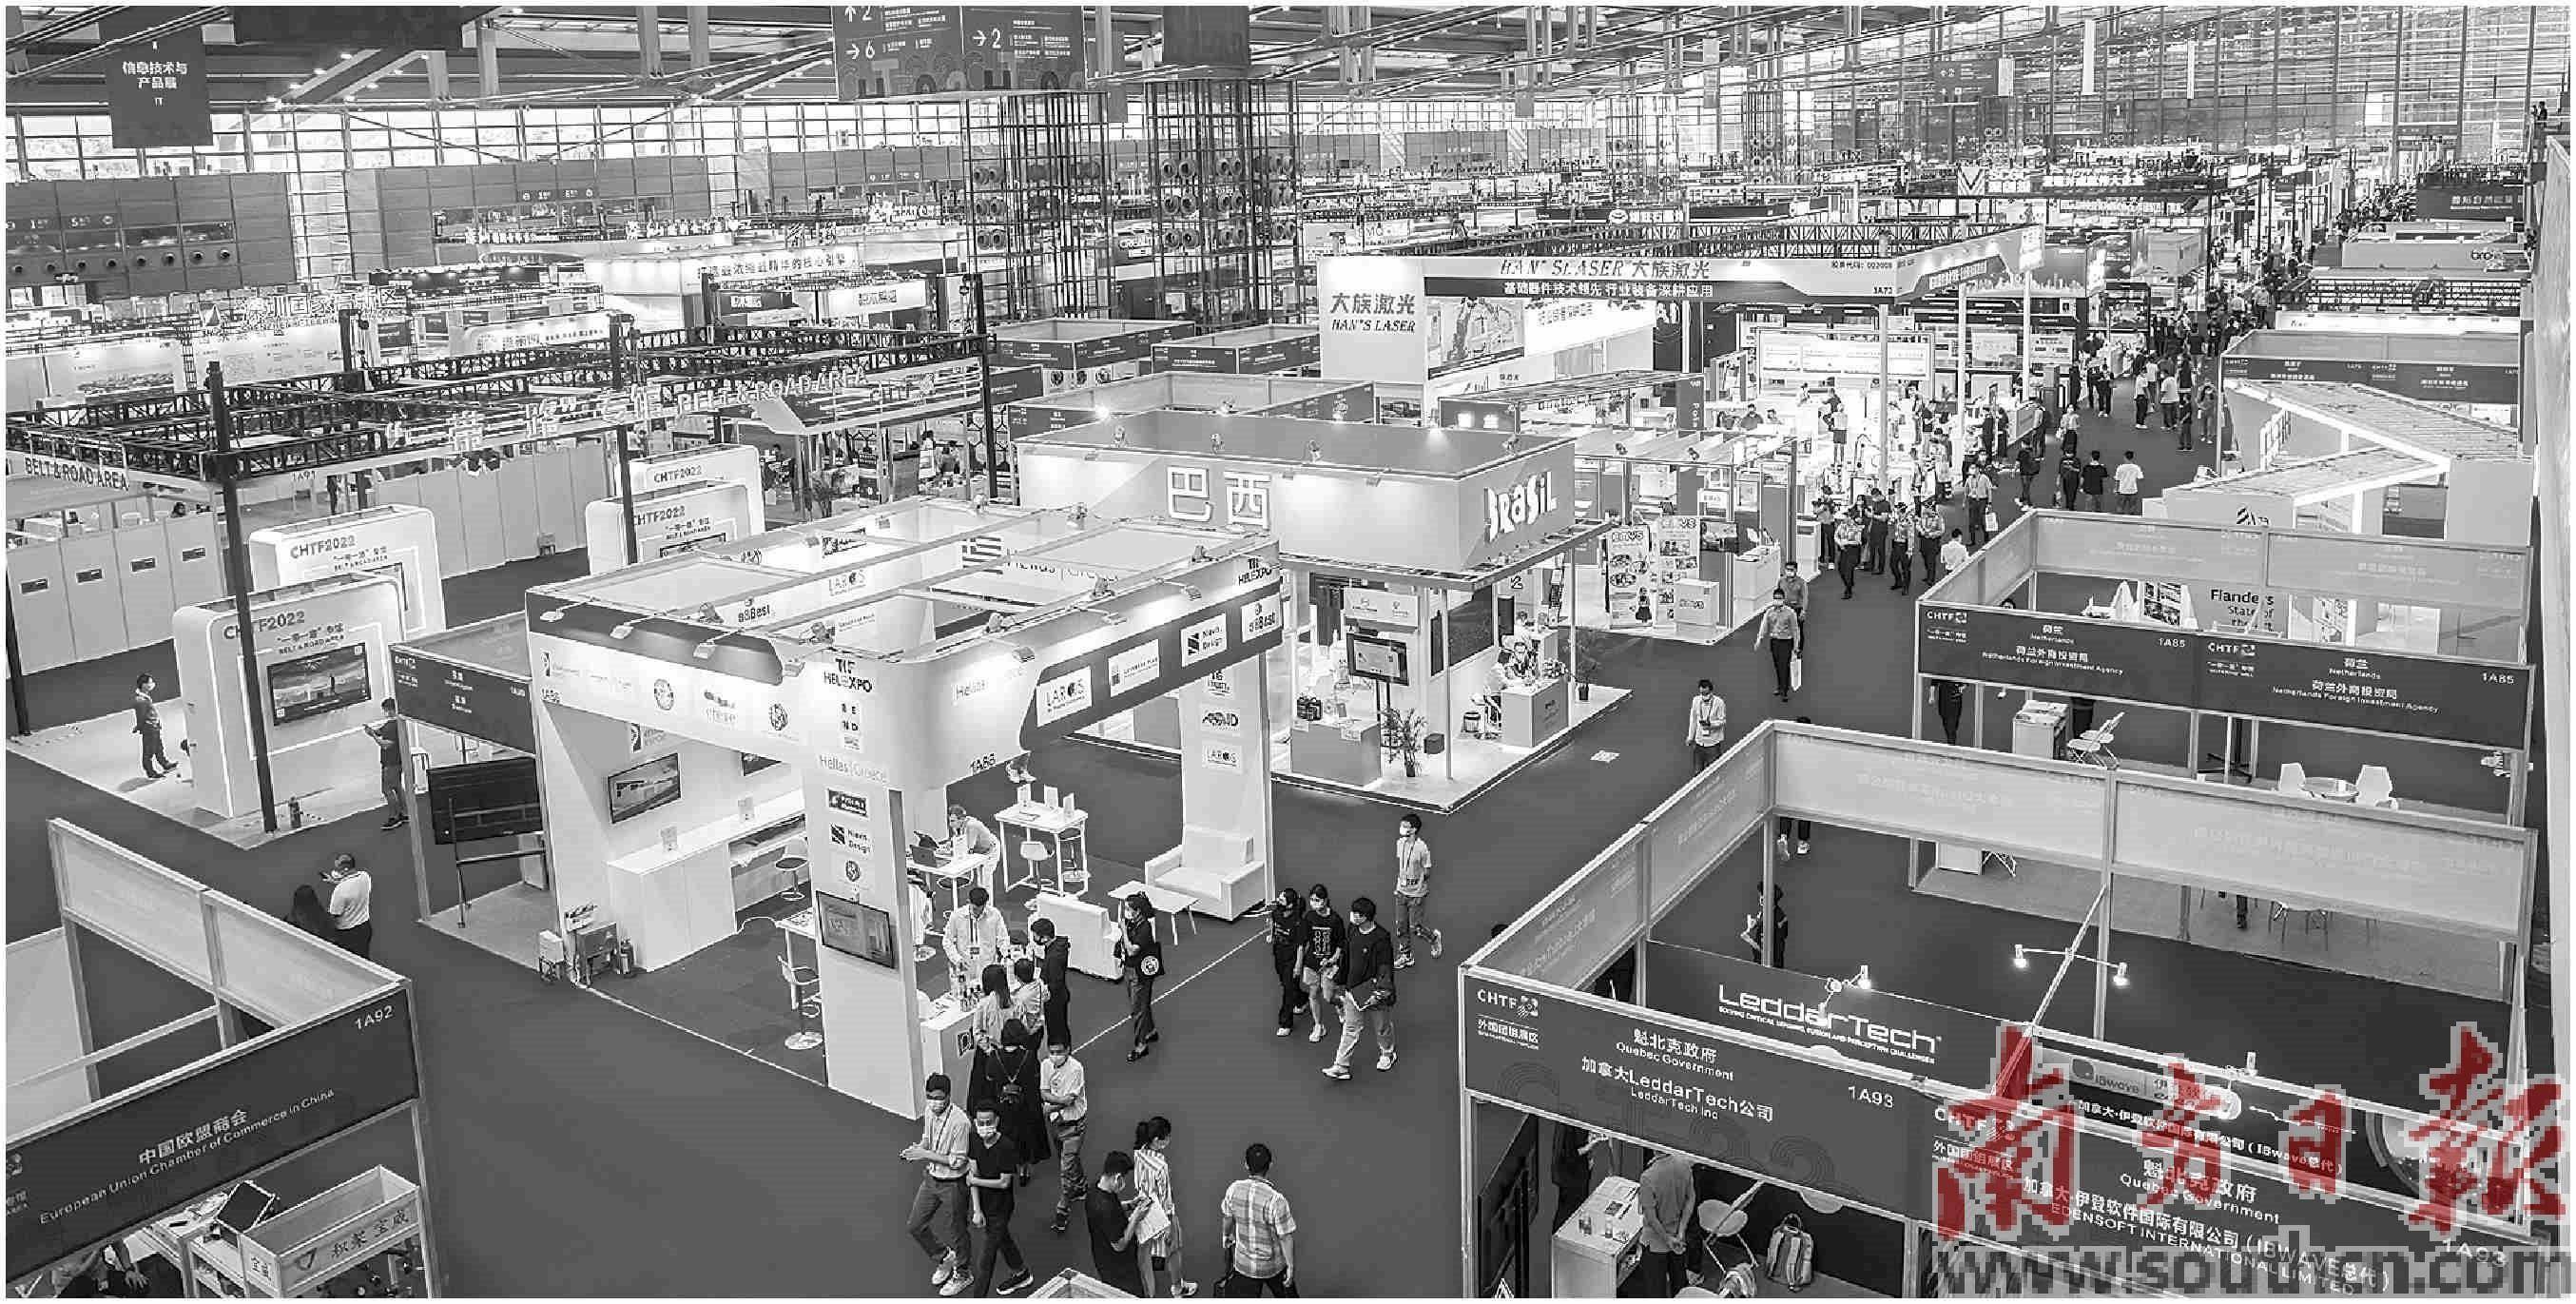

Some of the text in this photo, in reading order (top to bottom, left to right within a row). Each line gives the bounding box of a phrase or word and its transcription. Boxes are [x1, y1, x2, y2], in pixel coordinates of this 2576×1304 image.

[1329, 292, 1415, 315] 大族激光
[1375, 319, 1416, 333] LASER
[97, 470, 129, 492] AREA
[1166, 465, 1270, 530] 巴西
[290, 535, 357, 560] CHTF2022
[2211, 589, 2275, 606] Flandes
[223, 611, 305, 640] CHF2022
[2158, 637, 2185, 648] 1A85
[2329, 668, 2381, 680] Netherlands
[2482, 671, 2515, 685] 1A85
[1477, 988, 1518, 1009] CHTF
[354, 1004, 395, 1030] 1A92
[1718, 983, 1936, 1055] LeddarTech
[1632, 1027, 1718, 1065] 魁北克政府
[1616, 1041, 1734, 1082] Quebec Government
[1630, 1087, 1719, 1120] LeddarTech Inc
[1849, 1085, 1895, 1110] 1A93
[139, 1108, 249, 1166] 中国欧盟商会
[39, 1187, 107, 1225] European
[108, 1171, 148, 1195] Union
[150, 1143, 208, 1177] Chamber
[223, 1109, 288, 1143] Commerce
[301, 1087, 336, 1109] China
[2182, 1188, 2281, 1226] Government
[2050, 1201, 2137, 1236] EDENSOFT
[2140, 1226, 2278, 1276] INTERNATIONAL
